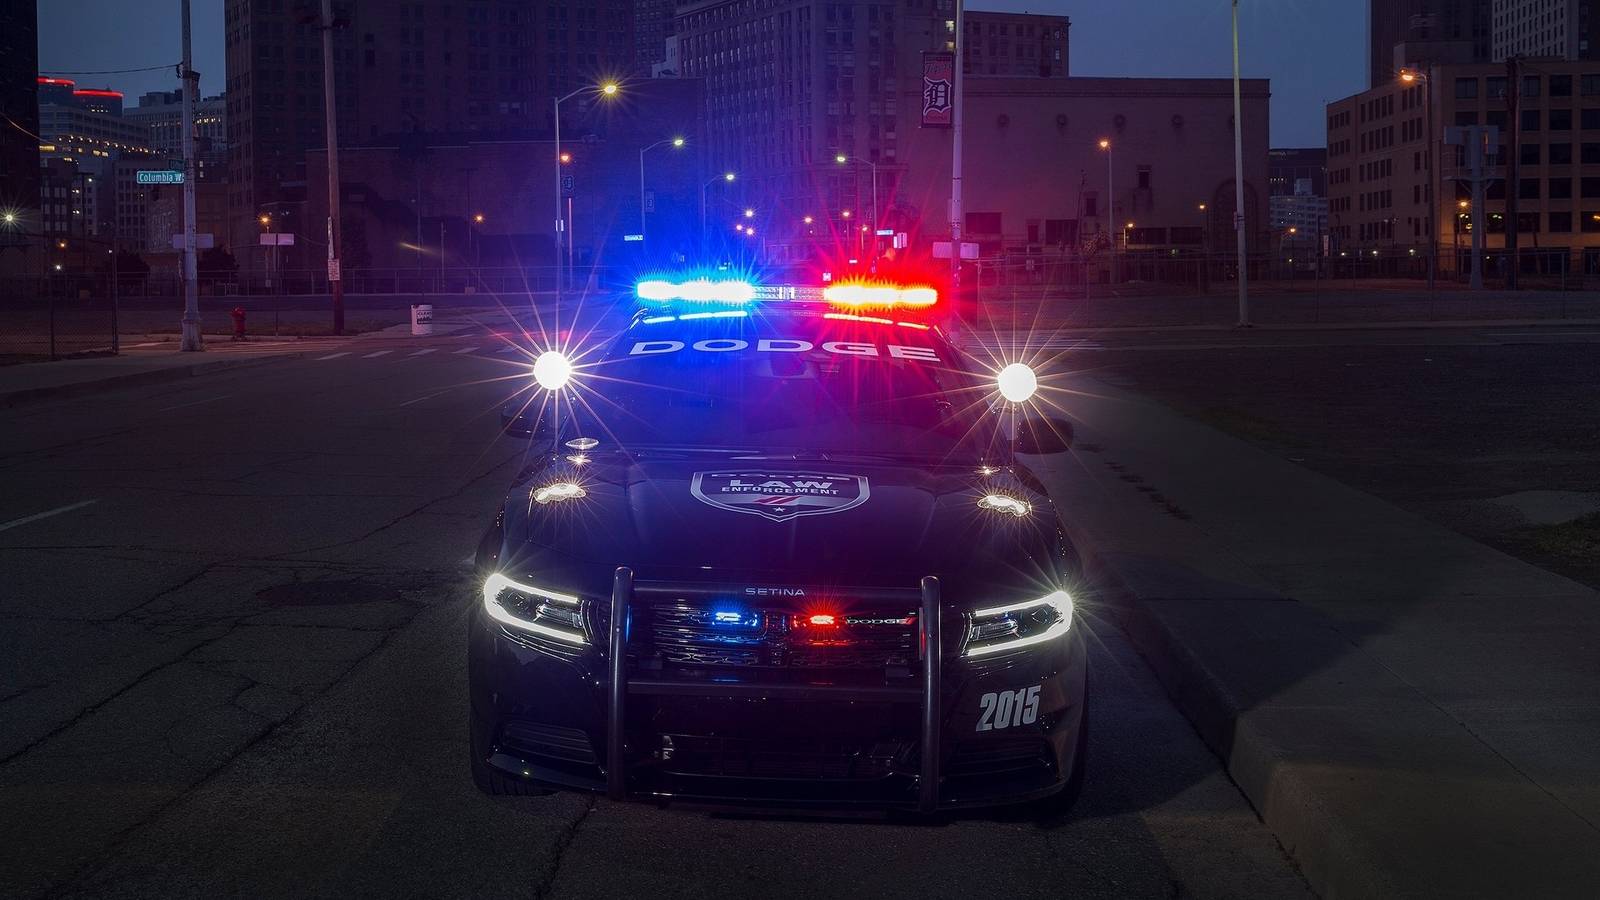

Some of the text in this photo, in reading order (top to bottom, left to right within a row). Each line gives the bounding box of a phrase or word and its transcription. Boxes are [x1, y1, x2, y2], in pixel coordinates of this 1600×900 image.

[139, 173, 173, 182] Columbia
[629, 339, 941, 362] DODGE
[729, 479, 833, 489] LAW
[721, 486, 840, 495] ENFORCEMENT
[745, 587, 806, 597] SETINA
[975, 685, 1042, 732] 2015
